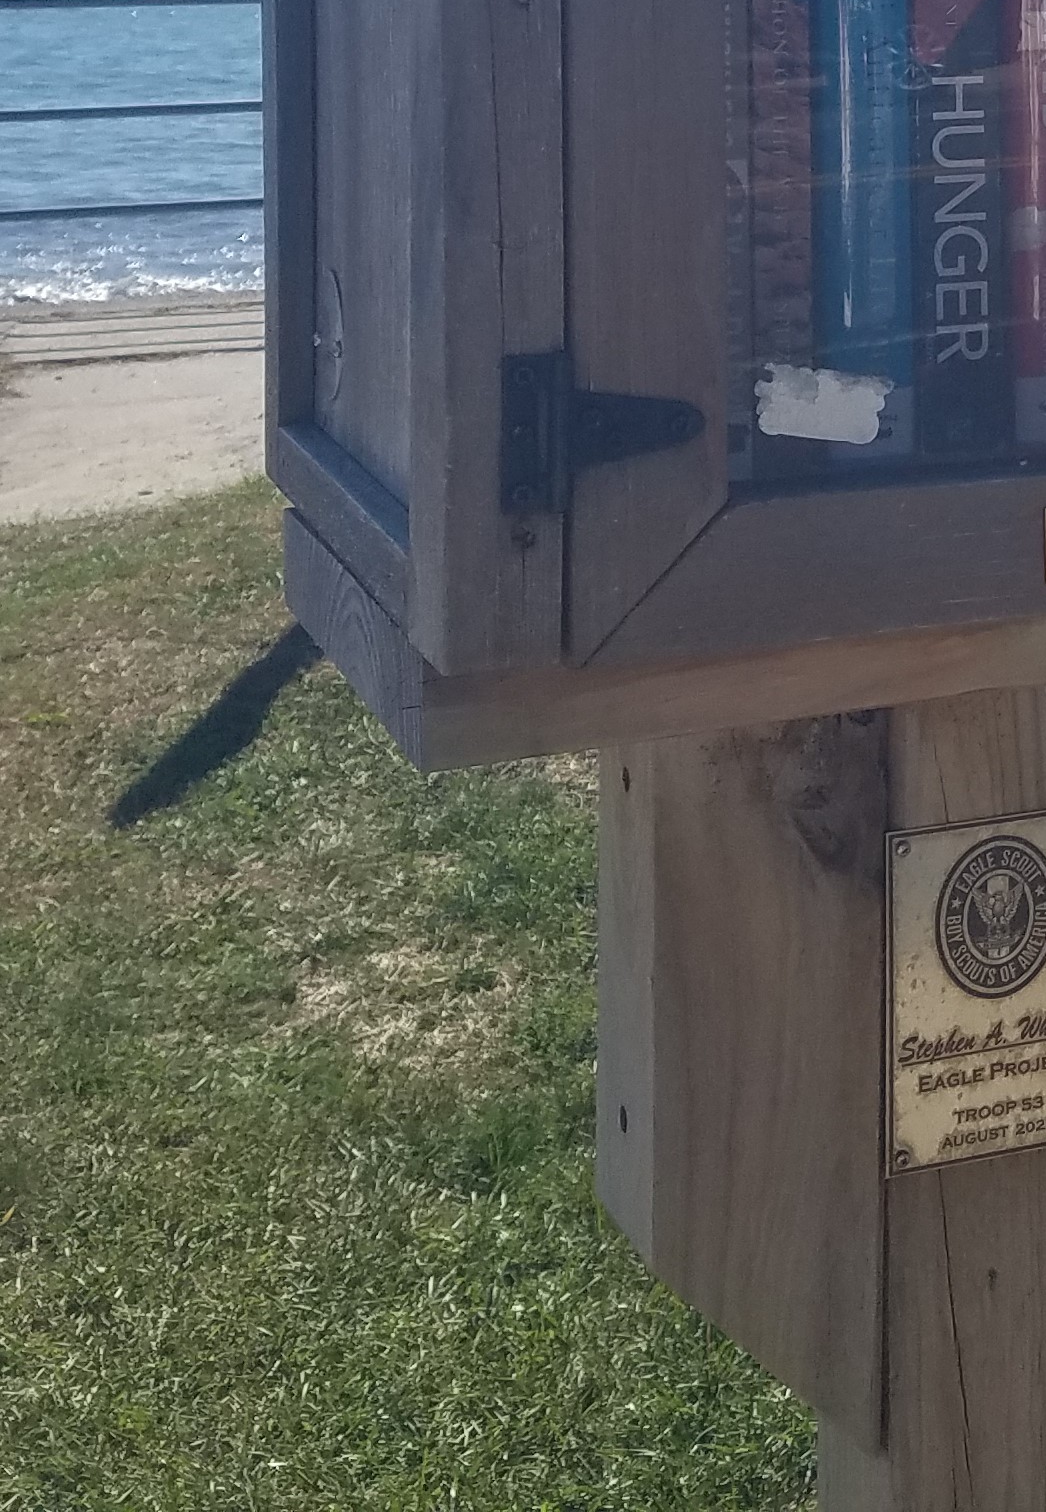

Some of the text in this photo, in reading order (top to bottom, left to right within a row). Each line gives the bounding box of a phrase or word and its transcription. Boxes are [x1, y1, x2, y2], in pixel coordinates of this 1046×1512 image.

[933, 75, 989, 365] HUNGER
[955, 849, 1043, 894] EAGLE SCOUT
[946, 914, 964, 945] BOY
[952, 944, 997, 986] SCOUTS
[999, 962, 1017, 983] OF
[897, 1032, 978, 1067] Stephen
[917, 1066, 986, 1094] EAGLE
[952, 1094, 1045, 1125] TROOP 53
[940, 1125, 1010, 1150] AUGUST
